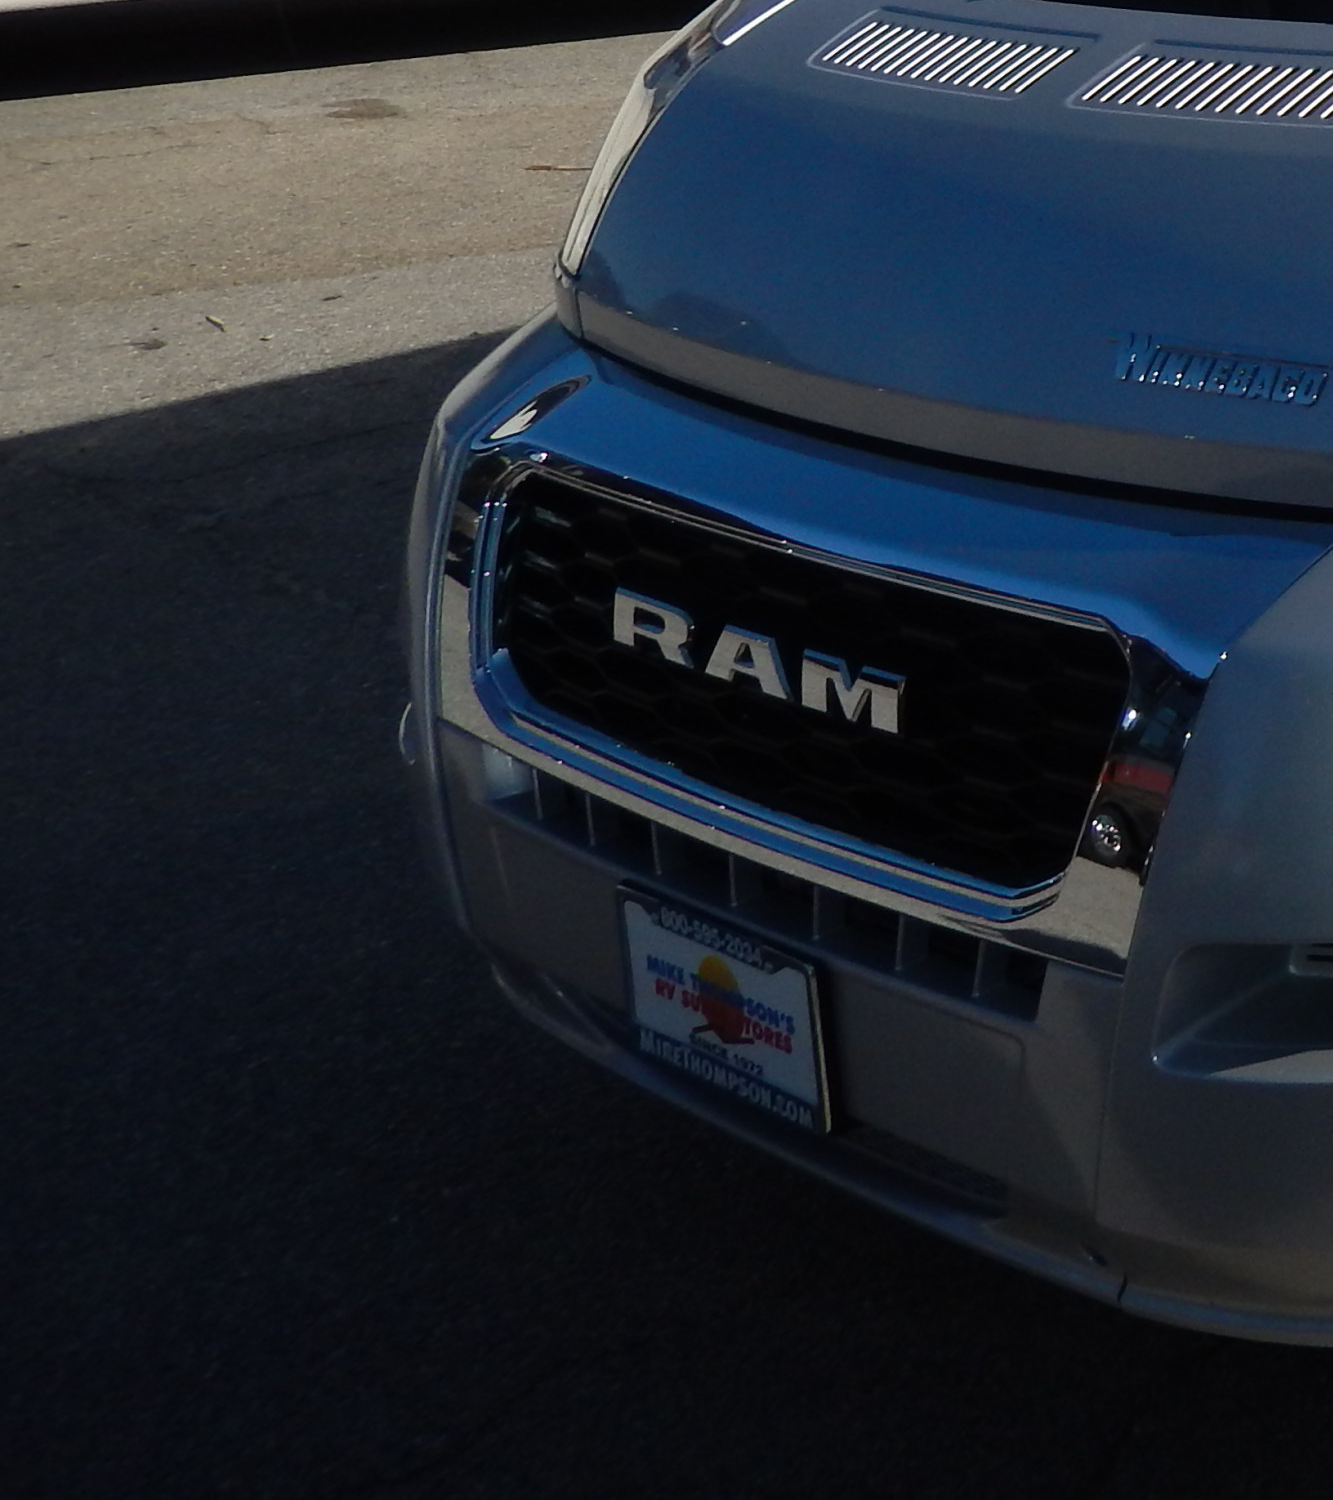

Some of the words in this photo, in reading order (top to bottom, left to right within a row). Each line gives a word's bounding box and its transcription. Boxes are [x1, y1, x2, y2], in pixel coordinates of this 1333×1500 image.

[1112, 332, 1333, 408] WINNEBAGO
[613, 586, 907, 735] RAM
[655, 978, 676, 1002] RV
[682, 990, 793, 1055] SUTORES
[691, 972, 796, 1036] TSON'S
